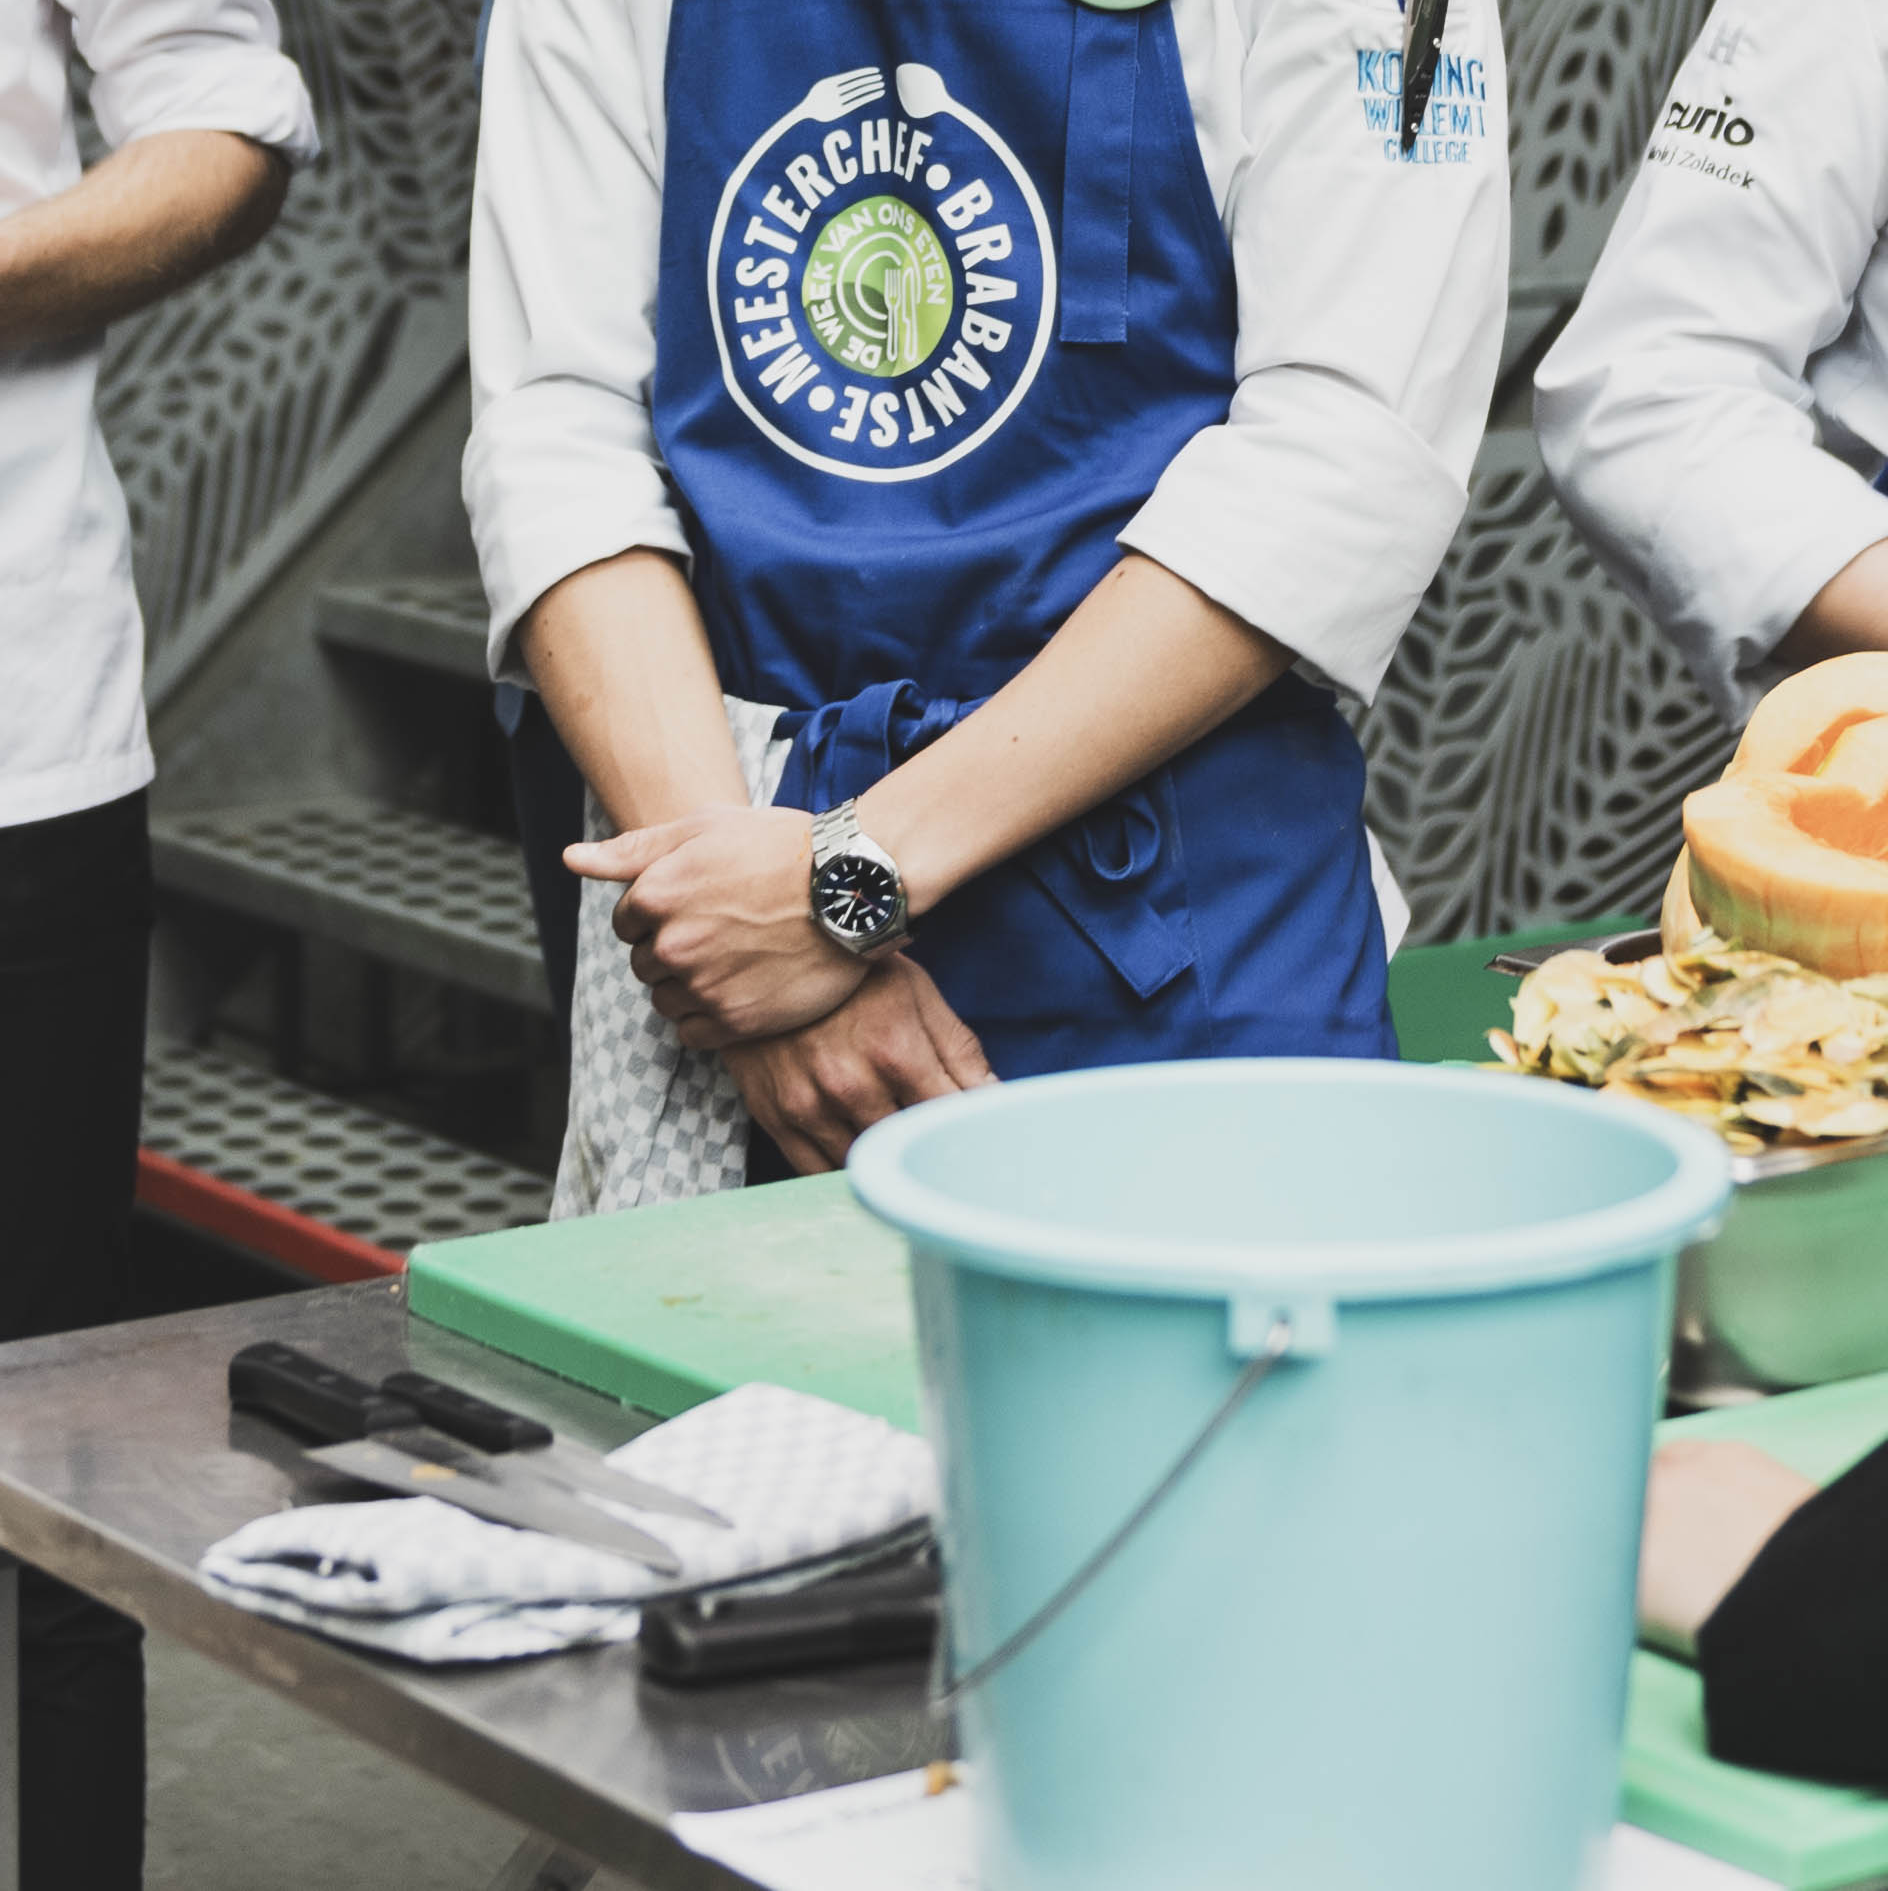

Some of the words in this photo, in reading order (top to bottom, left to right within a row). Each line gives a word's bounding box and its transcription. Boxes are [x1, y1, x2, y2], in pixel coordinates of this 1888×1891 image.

[1356, 48, 1486, 102] KOING
[820, 205, 877, 254] VAN
[877, 202, 917, 235] ONS
[734, 117, 934, 406] MEESTERCHEF
[914, 226, 947, 307] ETEN
[808, 258, 843, 346] WEEK
[830, 178, 1018, 448] BRABANTSE
[840, 336, 883, 370] DE
